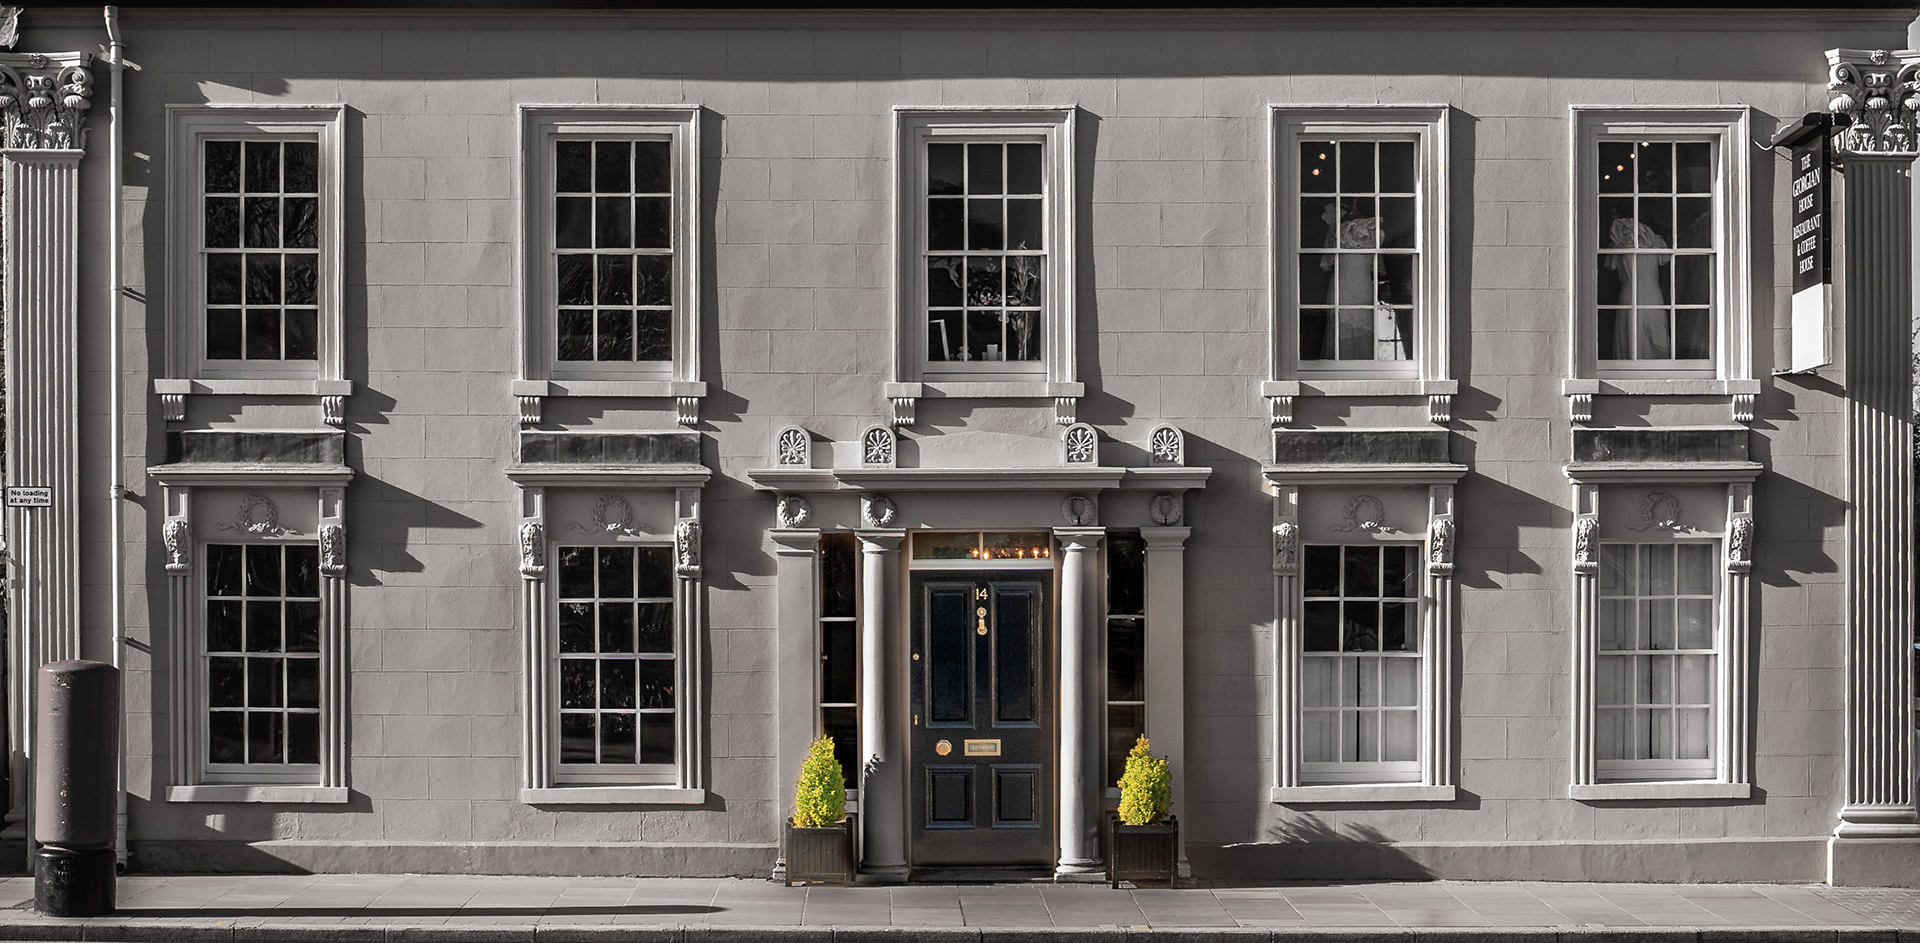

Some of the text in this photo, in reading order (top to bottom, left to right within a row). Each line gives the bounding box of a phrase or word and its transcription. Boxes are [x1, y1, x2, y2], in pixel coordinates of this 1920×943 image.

[1801, 153, 1811, 171] THE
[1792, 166, 1821, 198] GEORGIAN
[1798, 193, 1814, 214] HOUSE
[1793, 213, 1821, 240] RESTAURANT
[1797, 235, 1816, 257] & COFFEE
[1799, 255, 1814, 275] HOUSE
[975, 588, 988, 600] 14
